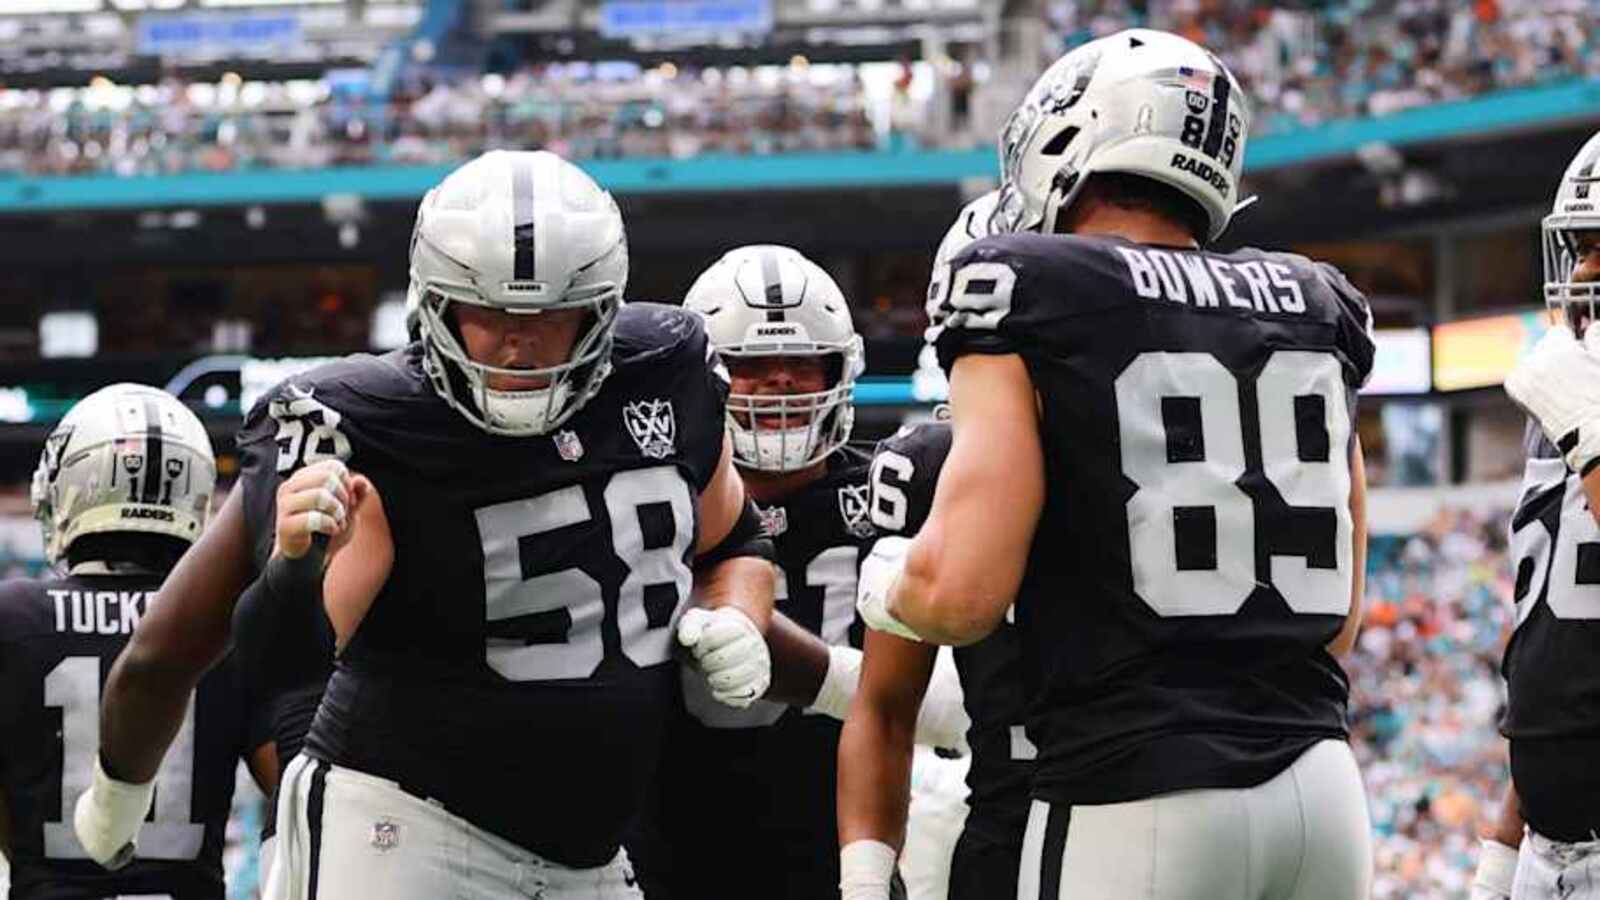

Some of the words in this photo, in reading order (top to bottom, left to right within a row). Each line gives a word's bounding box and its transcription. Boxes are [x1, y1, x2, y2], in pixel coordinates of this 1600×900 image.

[1116, 246, 1306, 313] BOWERS
[121, 508, 174, 522] RAIDERS
[1114, 350, 1353, 617] 89
[474, 465, 694, 681] 58
[48, 591, 172, 642] TUCK
